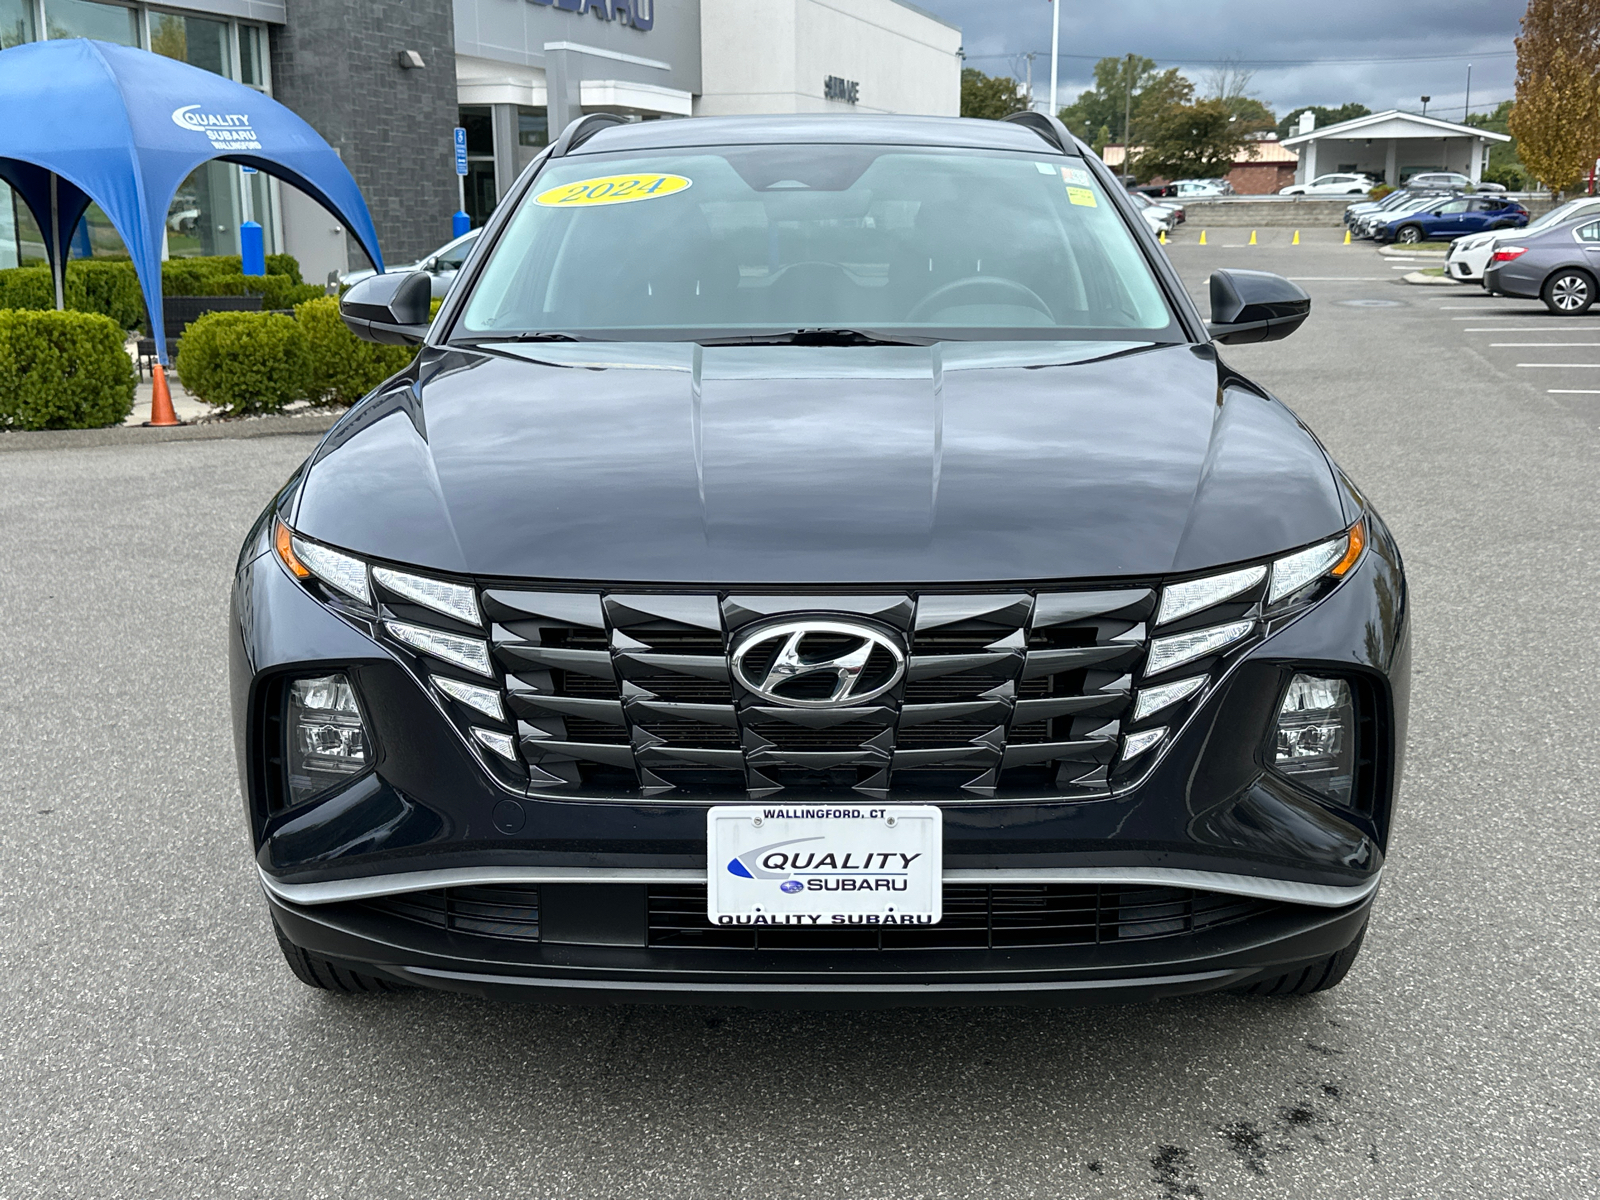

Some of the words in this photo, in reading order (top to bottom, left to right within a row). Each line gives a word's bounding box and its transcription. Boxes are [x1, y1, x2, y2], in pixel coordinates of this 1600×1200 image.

[184, 112, 249, 125] QUALITY
[205, 130, 257, 141] SUBARU
[558, 177, 667, 203] 2024
[763, 809, 865, 820] WALLINGFORD,
[869, 809, 886, 819] CT
[762, 852, 922, 871] QUALITY
[807, 878, 908, 892] SUBARU
[718, 914, 821, 925] QUALITY
[831, 914, 932, 925] SUBARU
